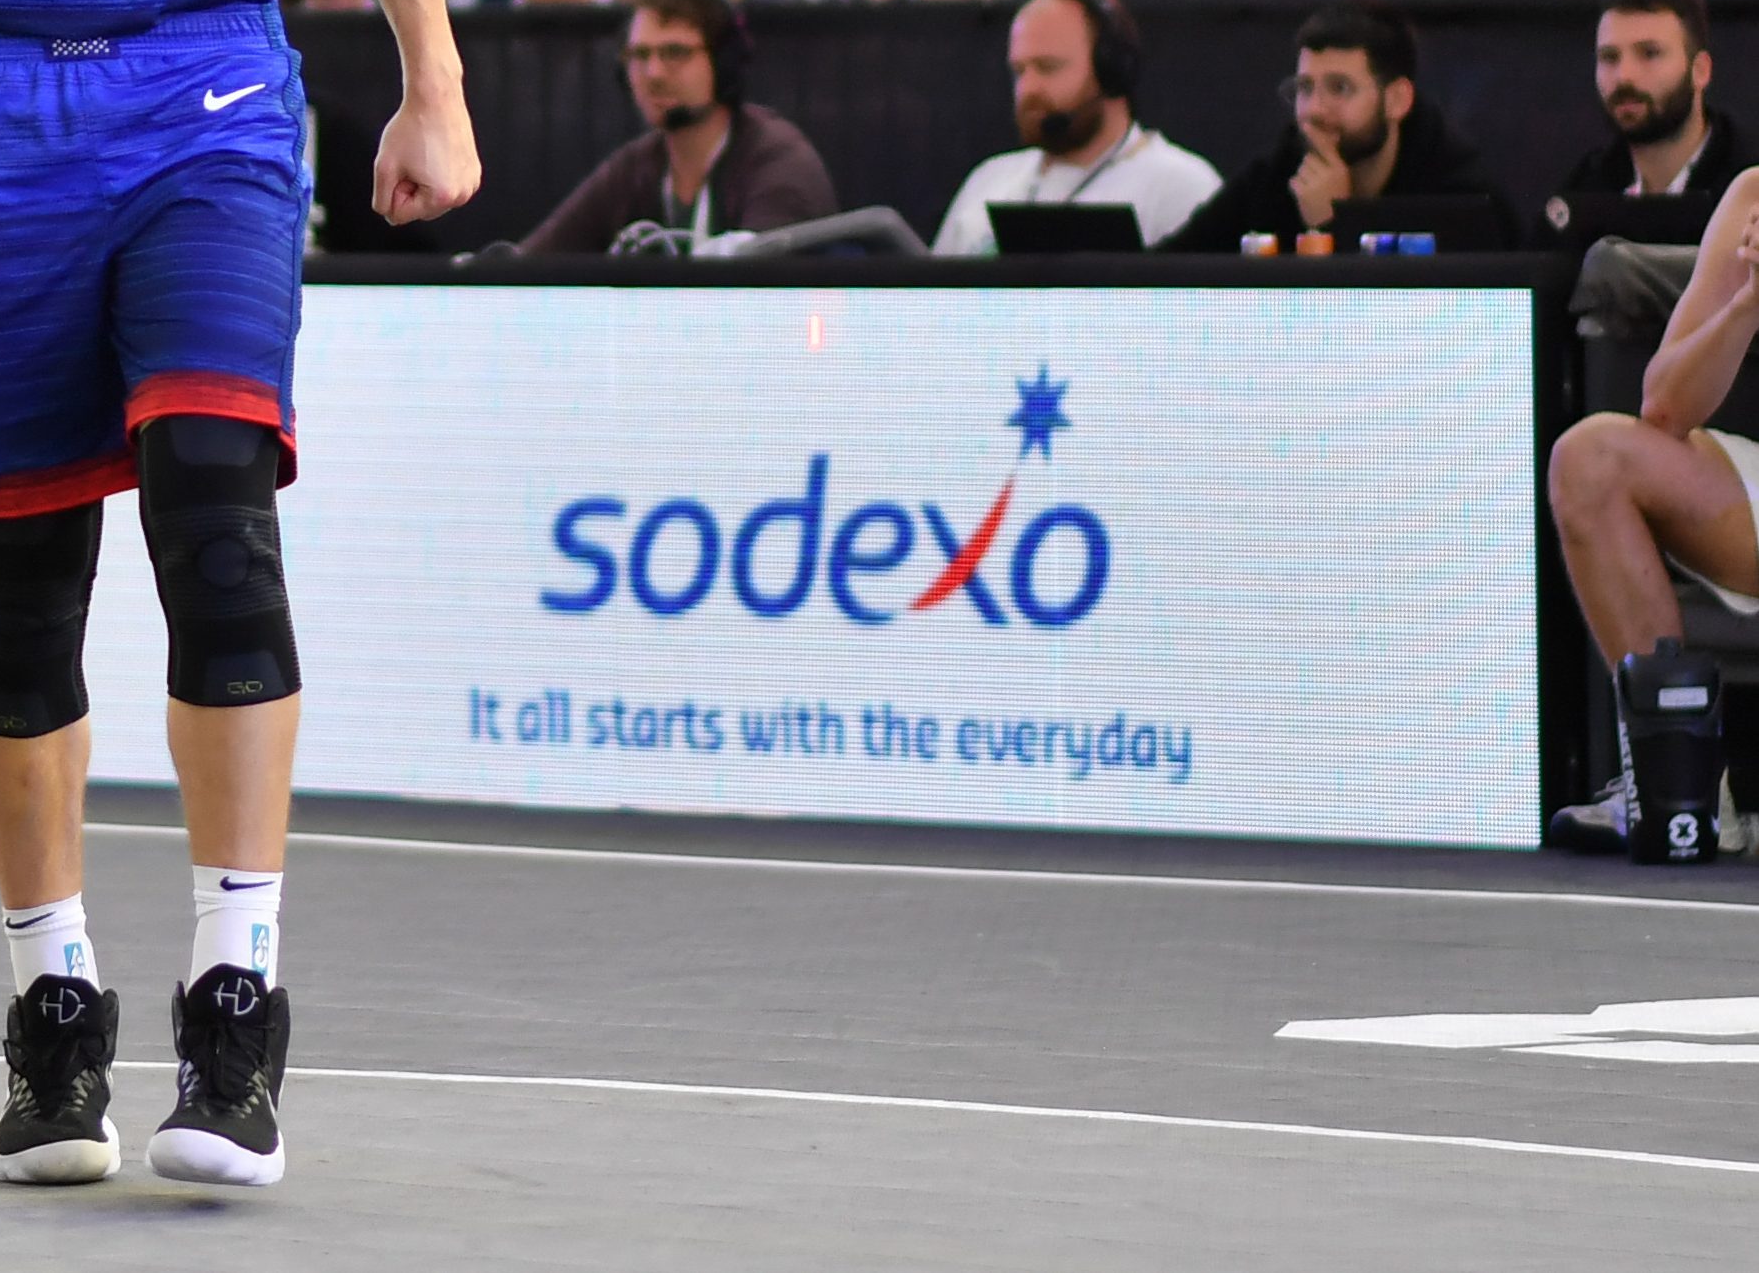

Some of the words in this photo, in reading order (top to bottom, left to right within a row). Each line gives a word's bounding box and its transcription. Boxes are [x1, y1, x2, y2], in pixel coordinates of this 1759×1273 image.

[539, 453, 1111, 629] sodexo
[470, 687, 501, 743] It
[516, 688, 571, 743] all
[587, 698, 724, 753] starts
[740, 699, 845, 757] with
[862, 700, 938, 762] the
[956, 709, 1192, 785] everyday
